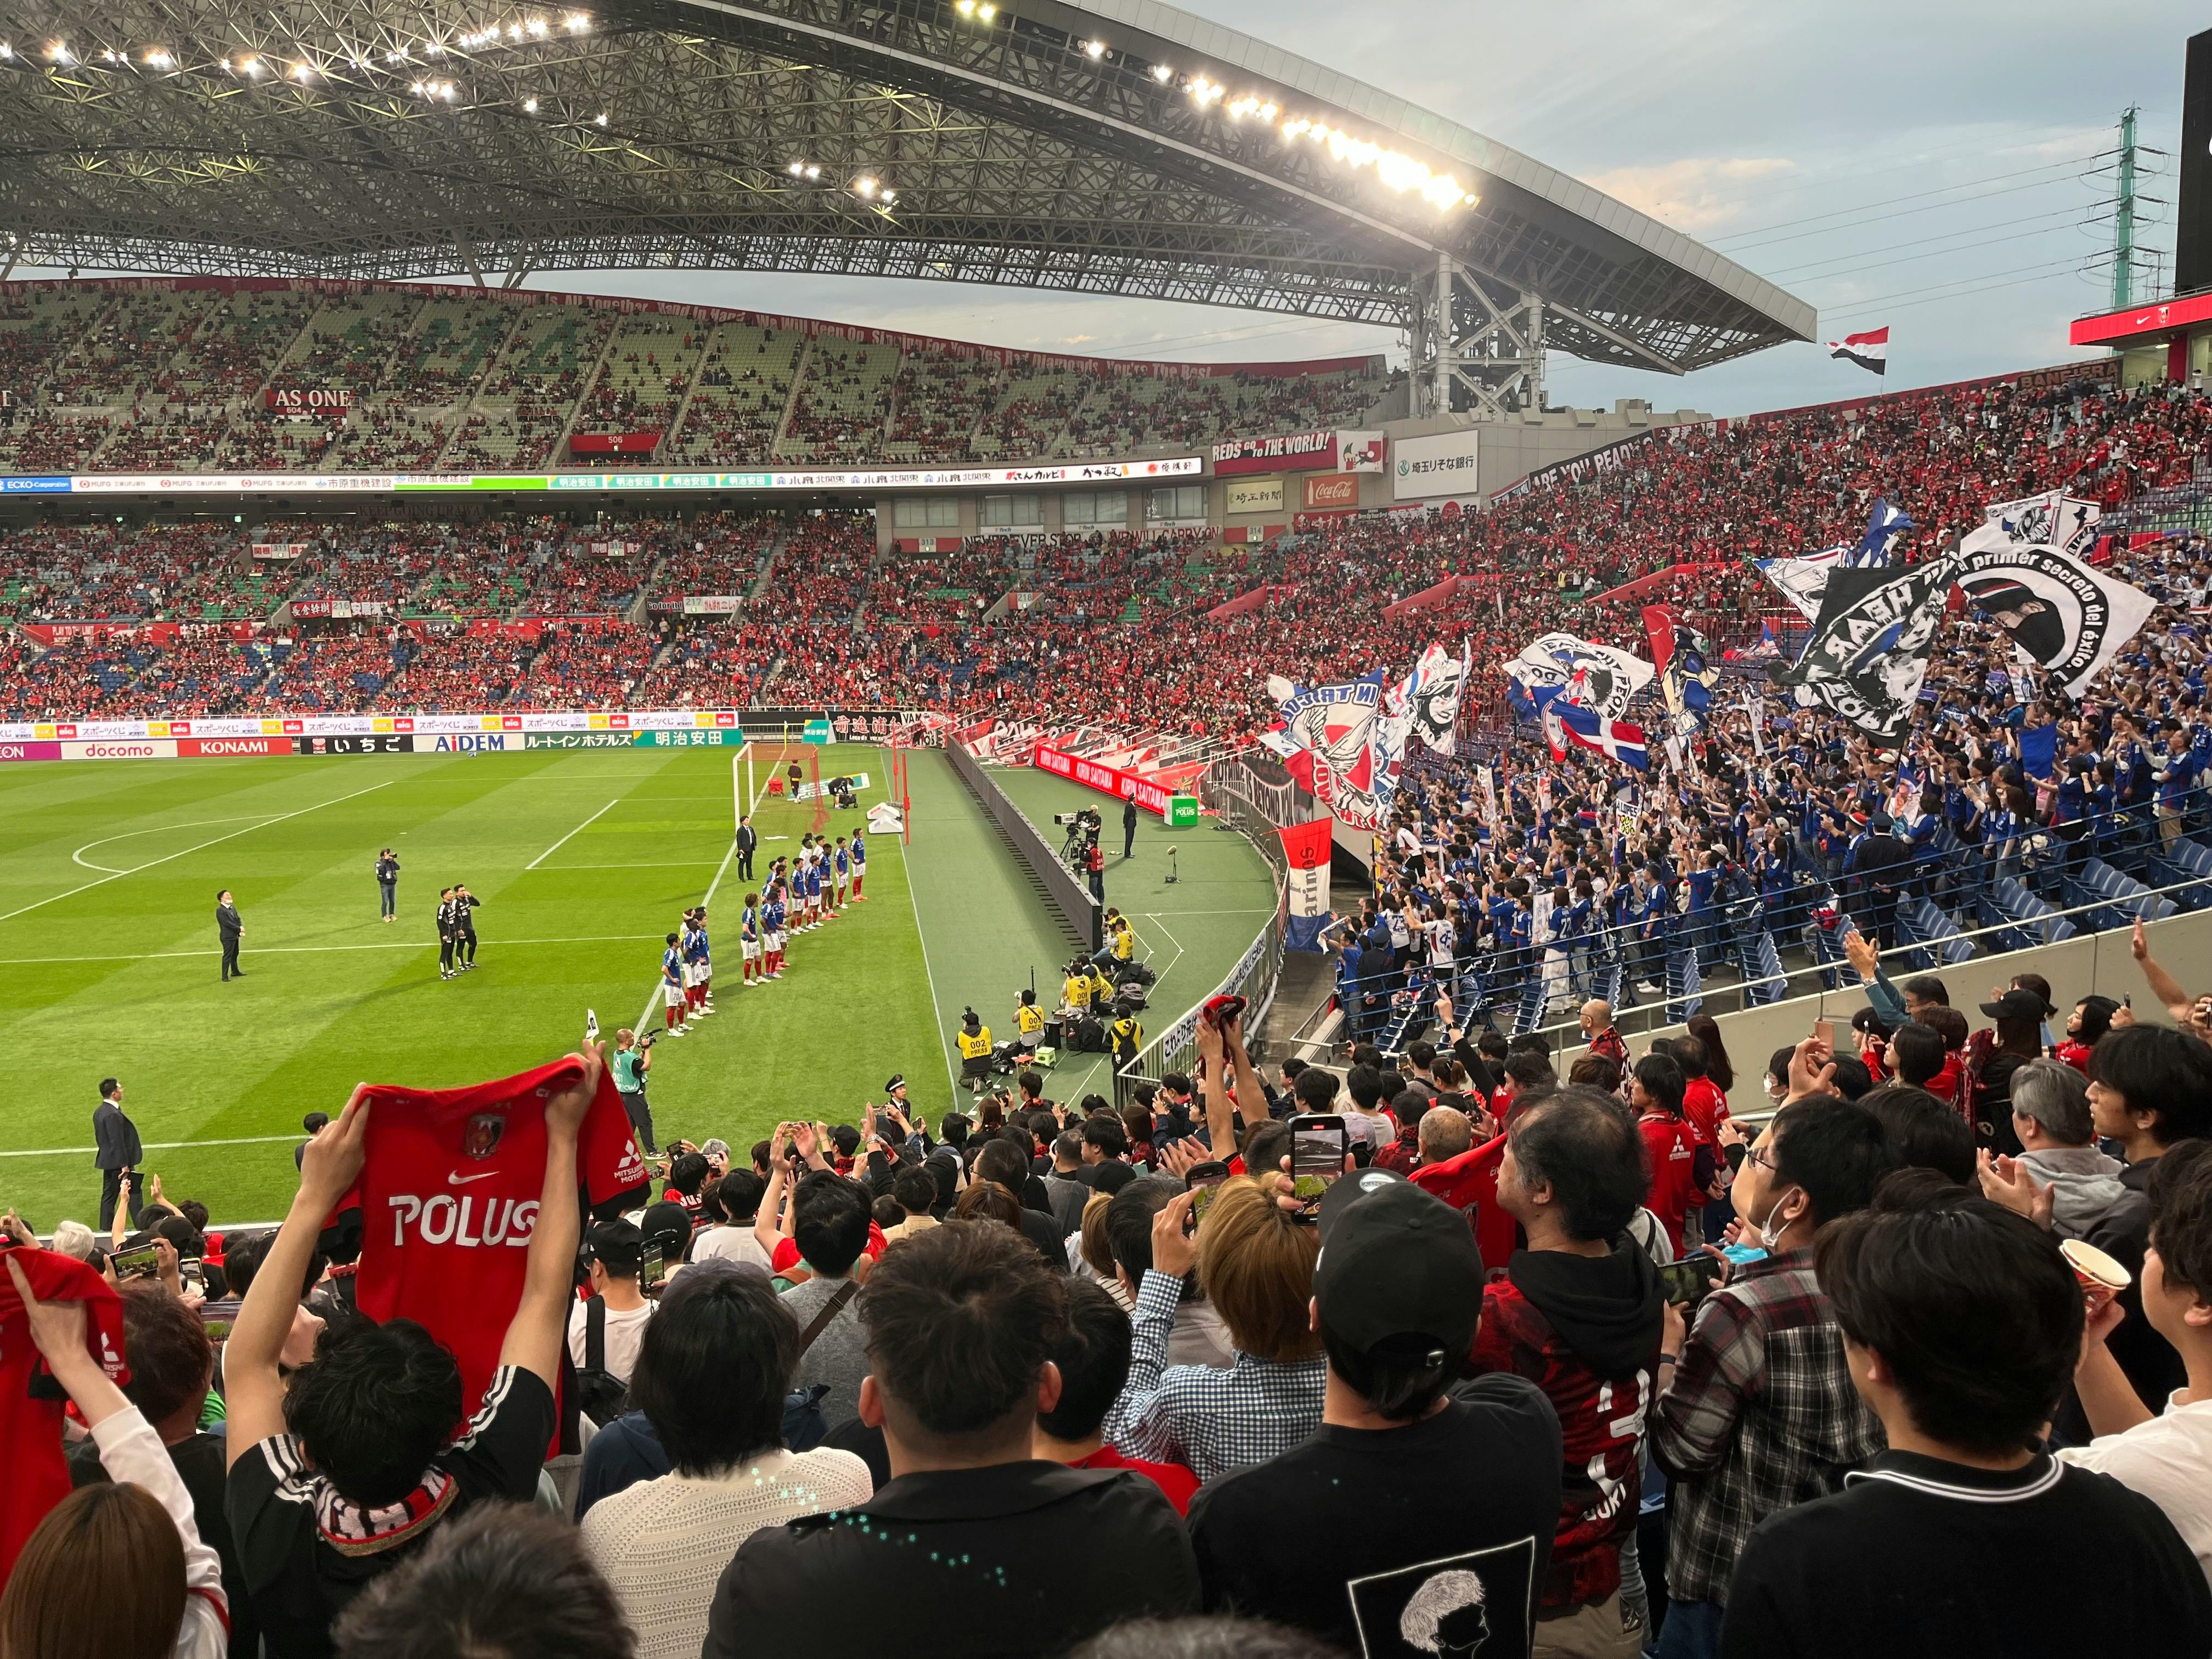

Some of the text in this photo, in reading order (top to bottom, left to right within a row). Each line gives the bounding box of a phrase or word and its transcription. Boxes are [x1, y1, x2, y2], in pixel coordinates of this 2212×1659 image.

[275, 390, 351, 407] AS ONE
[608, 436, 623, 444] 506
[1212, 432, 1330, 462] REDS GO TO THE WORLD!
[1412, 456, 1474, 473] 埼玉りそな銀行
[328, 478, 392, 488] 市原重機建設
[559, 478, 596, 487] 明治安田
[616, 477, 653, 487] 明治安田
[673, 477, 709, 486] 明治安田
[729, 476, 765, 486] 明治安田
[1236, 490, 1282, 504] 埼玉新聞
[1958, 559, 1969, 573] el
[1972, 550, 2040, 570] primer
[2041, 558, 2096, 602] secreto
[2084, 605, 2105, 626] del
[647, 601, 657, 611] Go
[658, 601, 670, 610] for
[52, 626, 64, 635] PLAY
[308, 723, 351, 731] スポーツくじ
[419, 720, 460, 729] スポーツくじ
[527, 719, 567, 728] スポーツくじ
[634, 718, 674, 726] スポーツくじ
[82, 727, 125, 735] スポーツくじ
[196, 724, 238, 733] スポーツくじ
[527, 734, 633, 749] ルートインホテルズ
[655, 731, 723, 745] 明治安田
[201, 741, 268, 754] KONAMI
[334, 737, 400, 753] いちご
[86, 744, 153, 757] docomo
[1040, 749, 1070, 774] KIRIN SAITAMA
[1076, 761, 1113, 790] KIRIN SAITAMA
[1121, 776, 1166, 810] KIRIN SAITAMA
[970, 1040, 986, 1049] 002
[970, 1048, 988, 1056] PRESS
[389, 1194, 541, 1248] POLUS
